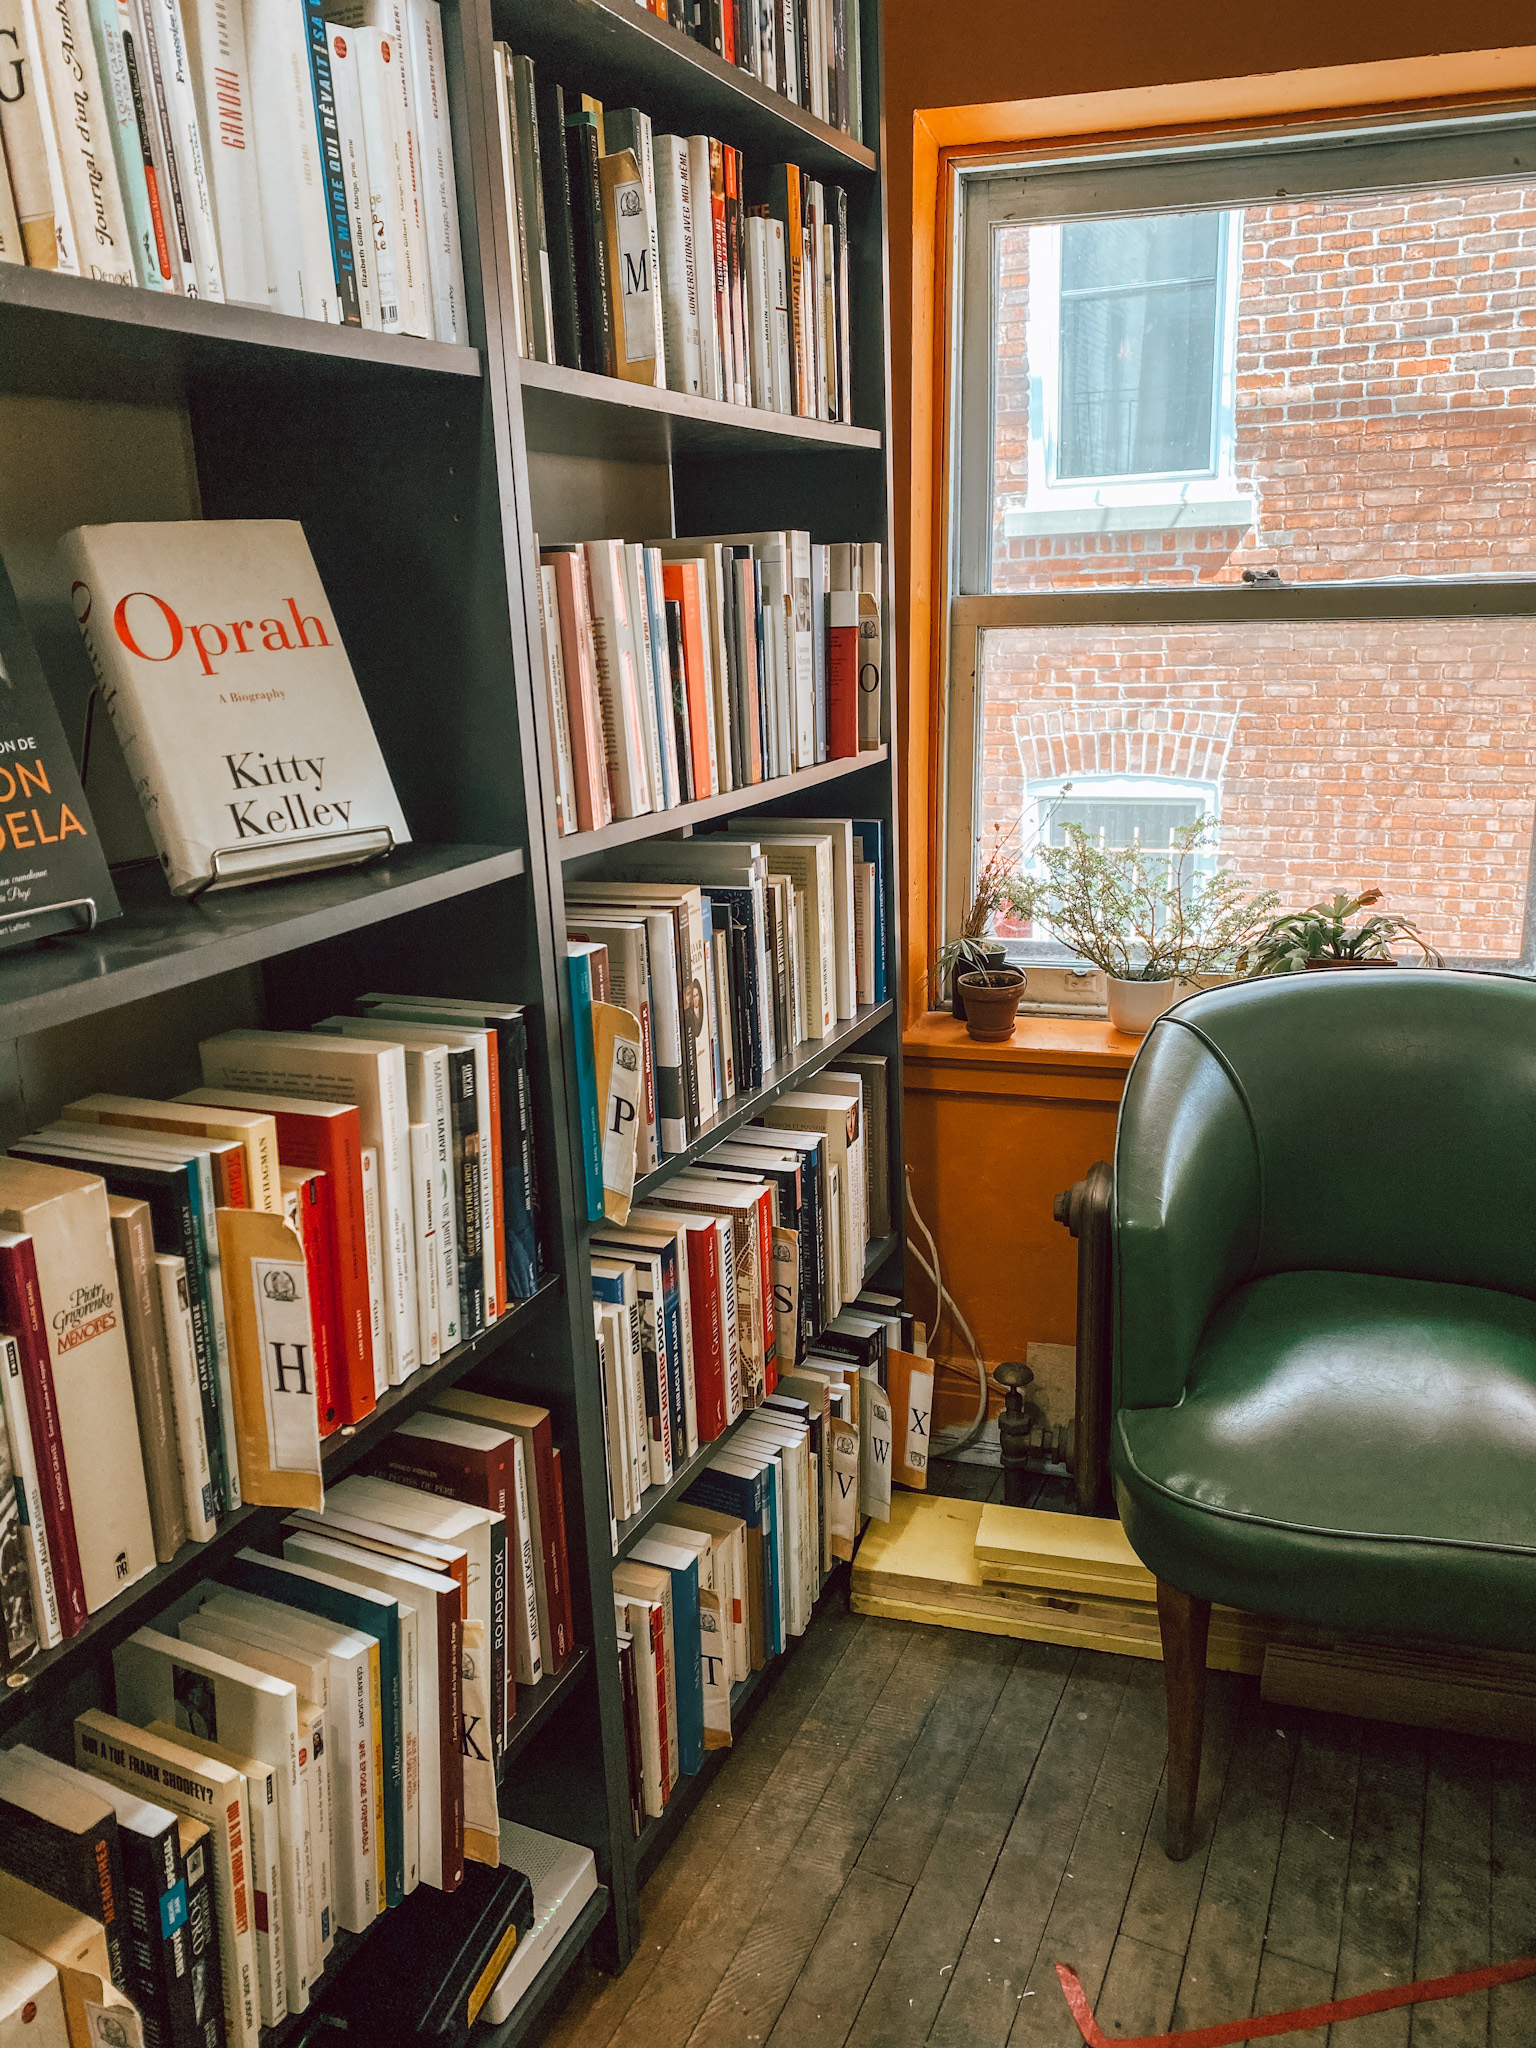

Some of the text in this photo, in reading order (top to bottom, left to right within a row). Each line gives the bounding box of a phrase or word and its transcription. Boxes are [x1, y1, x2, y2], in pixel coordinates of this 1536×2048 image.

[166, 15, 185, 85] Françoise
[311, 17, 324, 42] SA
[214, 67, 246, 150] GANDHI
[316, 55, 336, 130] RÊVAIT
[325, 138, 341, 173] QUI
[424, 18, 452, 255] Mange, prie, aime ELIZABETH GILBERT
[74, 91, 114, 246] Journal d'un
[331, 178, 351, 241] MAIRE
[346, 139, 369, 289] Elizabeth Gilbert Mange, prie, aime
[677, 150, 696, 316] CONVERSATIONS AVEC MOI-MÊME
[341, 249, 354, 271] LE
[623, 248, 650, 295] M
[597, 239, 610, 333] Le père Gédéon
[761, 310, 769, 343] MARTIN
[114, 592, 334, 677] Oprah
[218, 688, 286, 704] A Biography
[858, 663, 880, 693] O
[17, 736, 37, 751] DE
[221, 751, 326, 792] Kitty
[225, 794, 353, 840] Kelley
[687, 1026, 695, 1066] ASSELIN
[433, 1061, 444, 1113] MAURICE
[464, 1063, 474, 1097] HEARD
[643, 1019, 654, 1115] voyou Monsieur
[609, 1095, 635, 1136] P
[436, 1118, 447, 1163] HARVEY
[258, 1137, 270, 1192] HAGMAN
[480, 1135, 491, 1229] DANIÈLE HENKEL
[181, 1205, 192, 1236] GUAY
[464, 1163, 476, 1257] KIEFER SUTHERLAND
[185, 1240, 198, 1294] GUYLAINE
[25, 1280, 39, 1332] CLAUDE GRAVEL
[52, 1291, 114, 1336] Grigorenko
[70, 1284, 104, 1309] Piotr
[474, 1288, 482, 1327] TRANSIT
[765, 1293, 774, 1333] JOHN
[773, 1284, 794, 1314] S
[371, 1299, 380, 1337] Hardy
[630, 1301, 641, 1355] CAPTIVE
[723, 1229, 740, 1416] POURQUOI JE ME BATS
[7, 1345, 18, 1375] POINTS
[38, 1360, 47, 1384] l'espoir
[198, 1356, 209, 1392] DAME
[270, 1341, 312, 1395] H
[670, 1310, 682, 1413] MIRACLE EN ALASKA
[656, 1306, 671, 1463] SERIAL KILLERS DUOS
[910, 1407, 929, 1437] X
[50, 1443, 60, 1471] GRAVEL
[873, 1437, 890, 1466] W
[54, 1472, 66, 1511] RAYMOND
[835, 1471, 855, 1500] V
[31, 1489, 58, 1625] Grand Corps Malade Patients
[494, 1548, 504, 1650] ROADBOOK
[522, 1539, 539, 1641] MICHAEL JACKSON
[356, 1666, 364, 1698] GÉRARD
[700, 1654, 724, 1687] T
[357, 1698, 365, 1729] JUGNOT
[358, 1740, 367, 1757] UNE
[459, 1713, 490, 1762] K
[82, 1733, 214, 1805] QUI A TUÉ FRANK SHOOFEY?
[391, 1745, 401, 1779] Julien
[226, 1800, 240, 1822] QUI
[229, 1822, 241, 1832] A
[360, 1799, 370, 1856] FORMIDABLE
[230, 1833, 243, 1851] TUÉ
[231, 1850, 245, 1887] FRANK
[269, 1865, 278, 1898] manque
[163, 1835, 185, 1978] ENVOYÉ SPÉCIAL
[189, 1892, 205, 1956] FORD
[234, 1885, 249, 1936] SHOOFEY?
[272, 1936, 280, 1957] force
[274, 1971, 282, 1989] Joly
